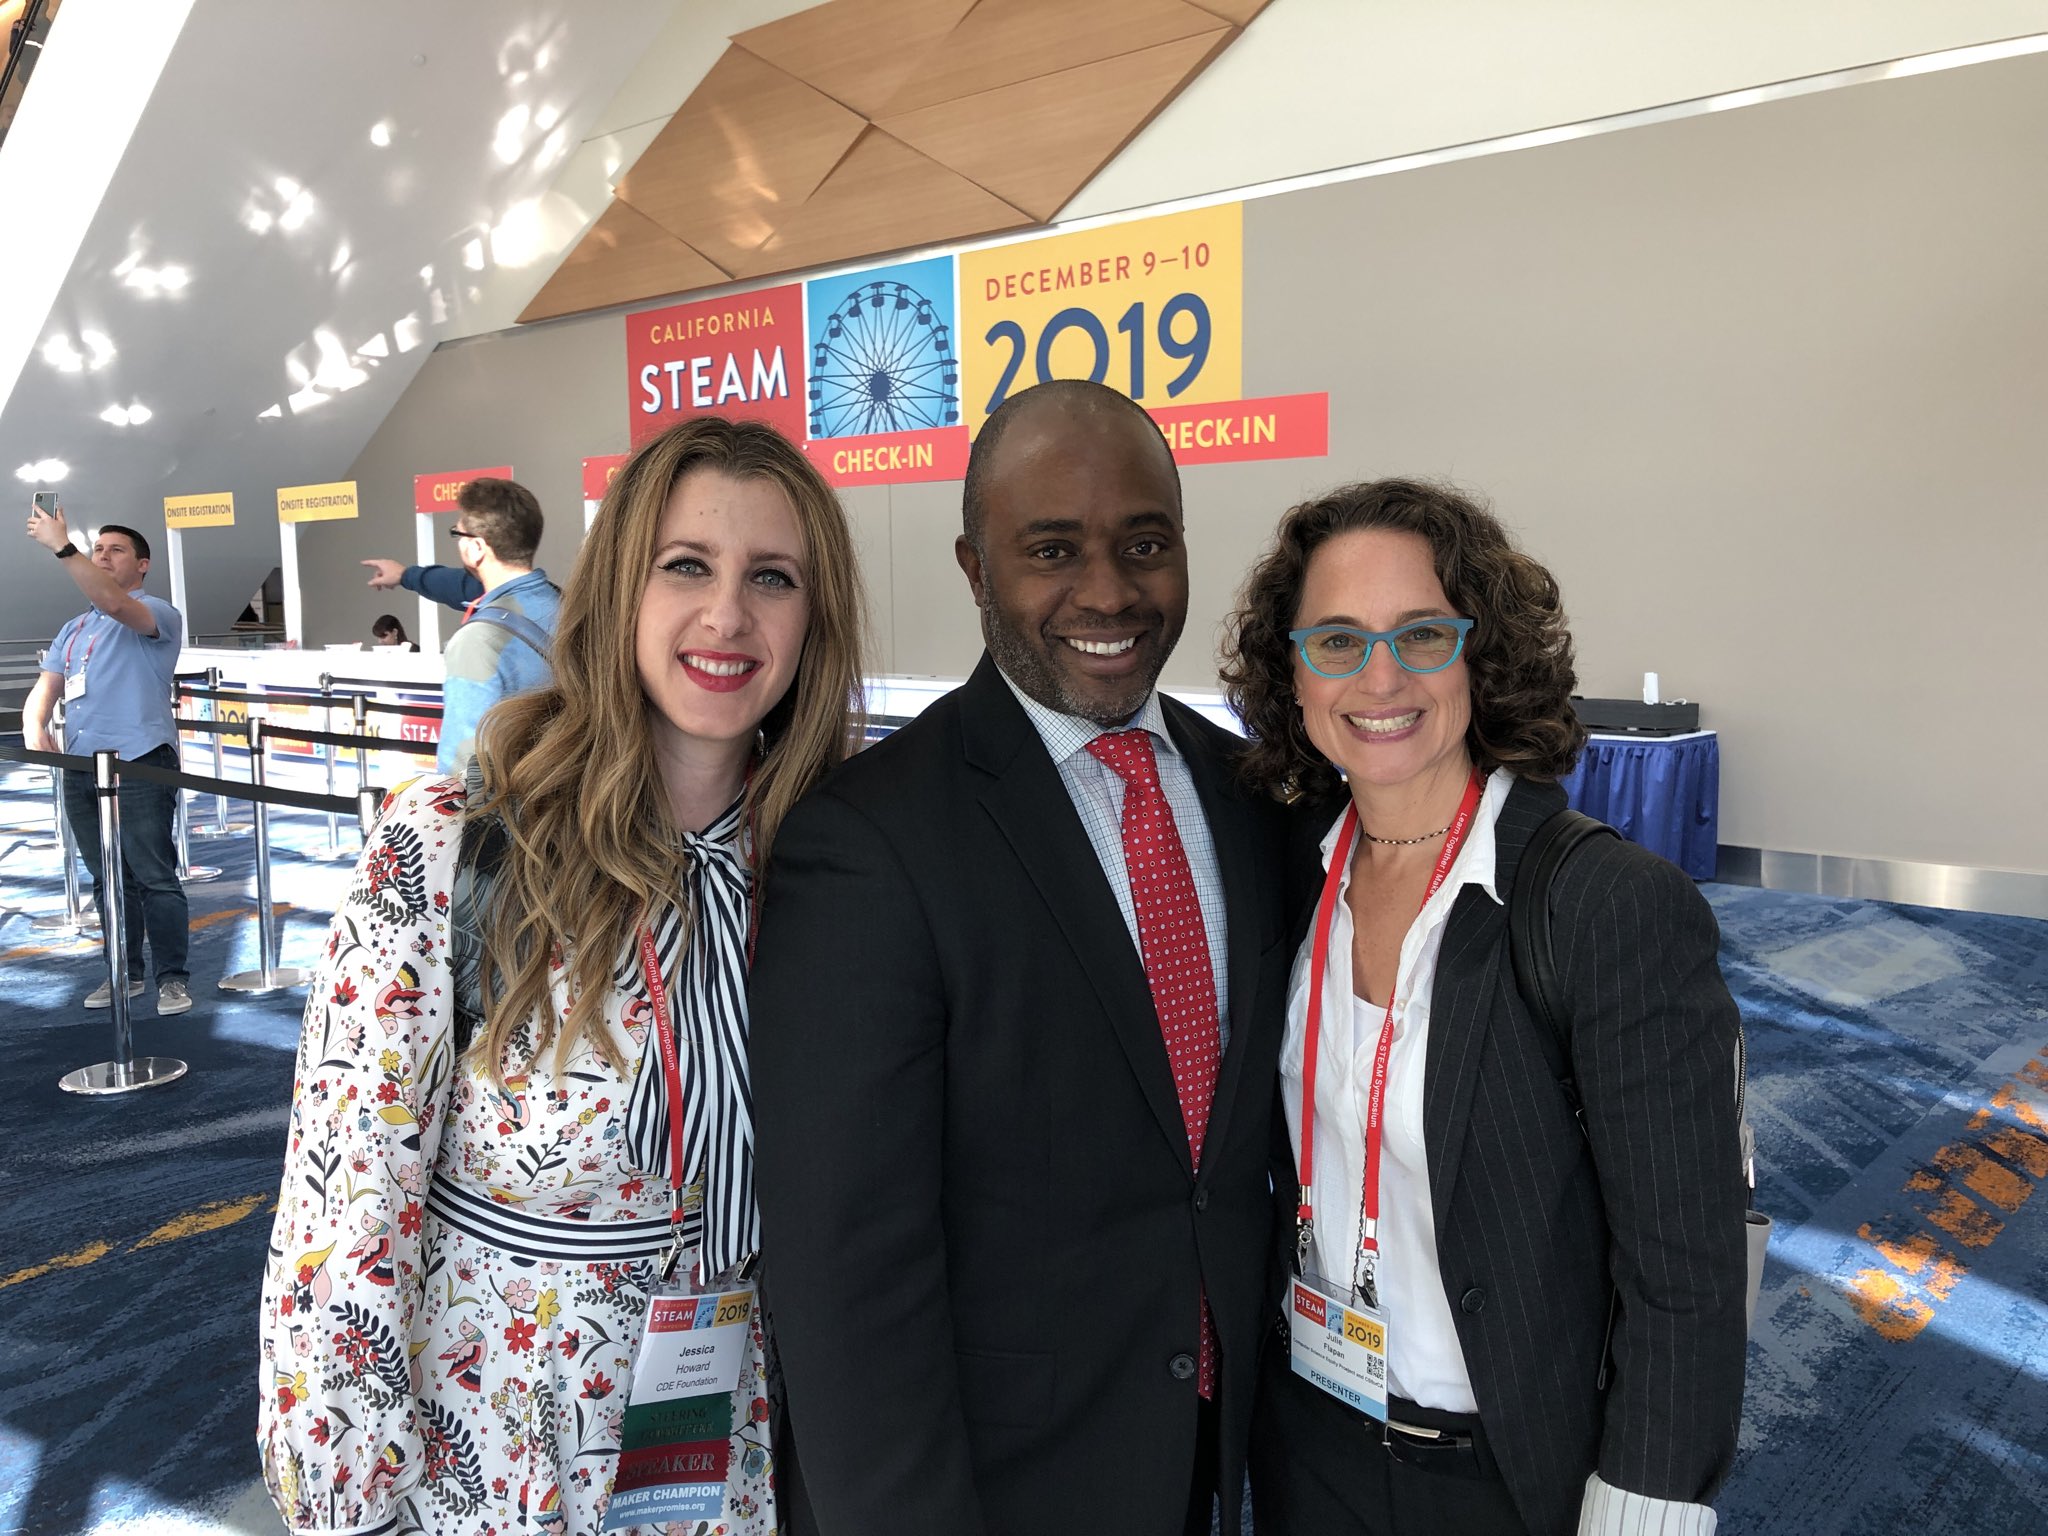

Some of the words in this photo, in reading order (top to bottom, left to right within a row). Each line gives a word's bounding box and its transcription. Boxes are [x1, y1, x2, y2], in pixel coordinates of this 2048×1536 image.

[986, 255, 1130, 301] DECEMBER
[650, 306, 775, 344] CALIFORNIA
[985, 293, 1211, 415] 2019
[640, 345, 789, 414] STEAM
[1158, 414, 1276, 450] HECK-IN
[833, 443, 933, 474] CHECK-IN
[167, 506, 188, 518] ONSITE
[189, 504, 231, 517] REGISTRATION
[279, 499, 304, 511] ONSITE
[305, 494, 355, 509] REGISTRATION
[402, 723, 440, 744] STEA
[1454, 812, 1468, 835] Learn
[1440, 836, 1459, 870] Together
[644, 941, 659, 983] California
[653, 984, 667, 1019] STEAM
[660, 1020, 675, 1071] Symposium
[1375, 1045, 1387, 1078] STEAM
[1370, 1078, 1383, 1128] Symposium
[654, 1310, 693, 1322] STEAM
[717, 1302, 749, 1322] 2019
[1296, 1294, 1325, 1317] STEAM
[1326, 1332, 1343, 1346] Julie
[1347, 1322, 1381, 1348] 2019
[679, 1344, 715, 1357] Jessica
[1323, 1342, 1345, 1359] Flapan
[676, 1361, 711, 1374] Howard
[656, 1380, 675, 1392] CDE
[676, 1376, 718, 1389] Foundation
[1311, 1369, 1361, 1405] PRESENTER
[624, 1453, 715, 1478] SPEAKER
[611, 1491, 650, 1509] MAKER
[653, 1485, 721, 1501] CHAMPION
[620, 1502, 705, 1518] www.makerpromise.org
